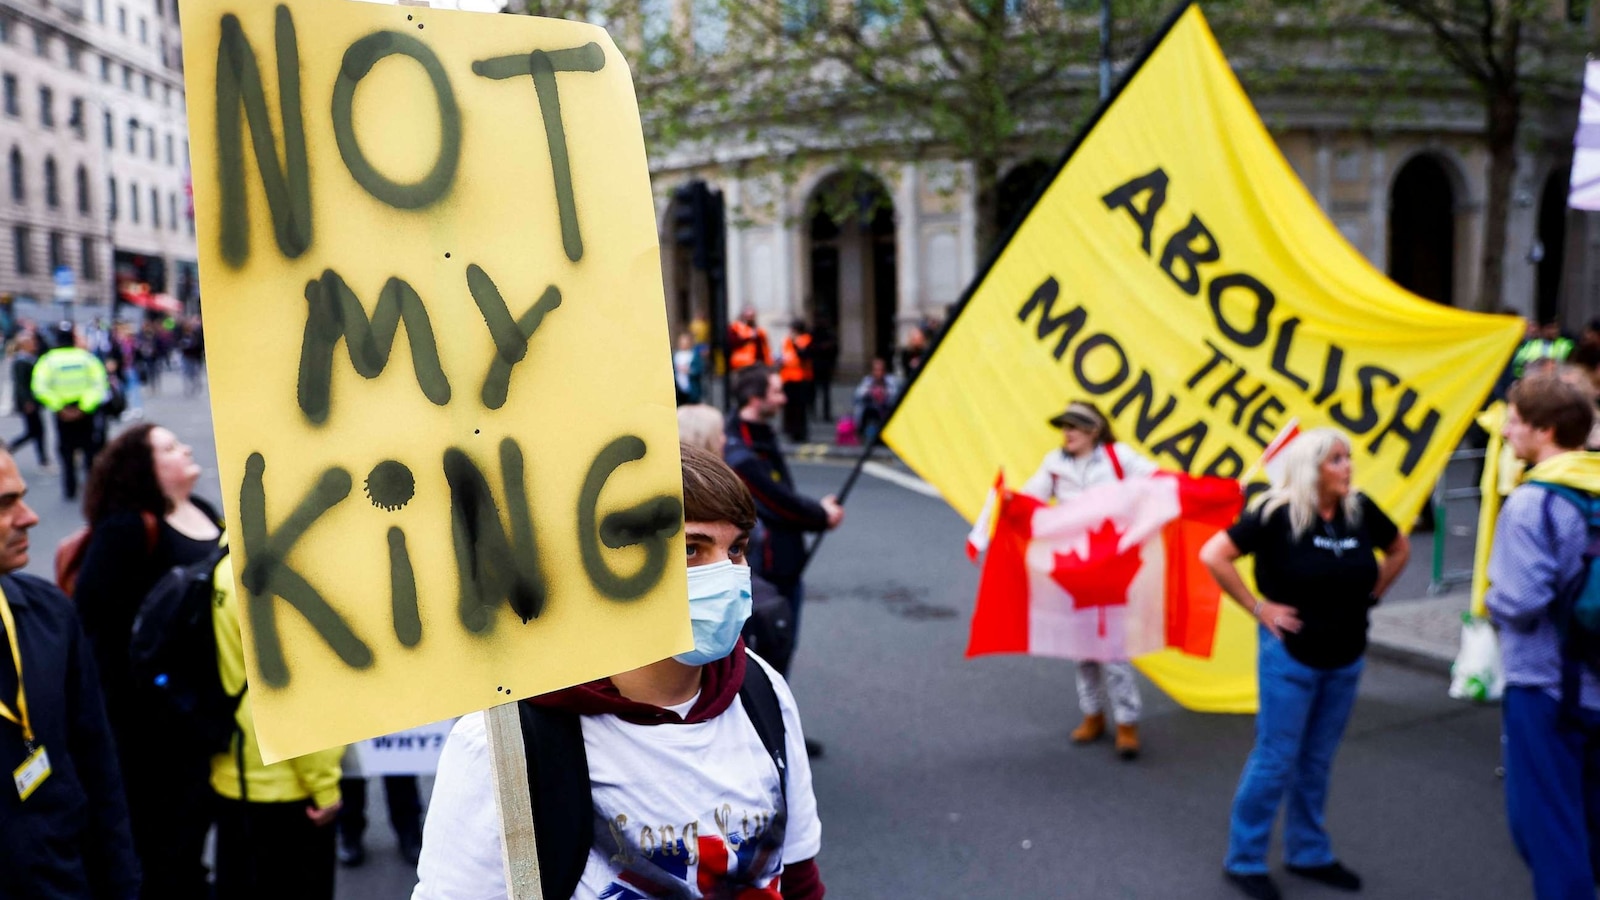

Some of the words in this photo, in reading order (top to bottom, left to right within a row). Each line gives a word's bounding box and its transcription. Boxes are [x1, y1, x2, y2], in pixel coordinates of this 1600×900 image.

[215, 3, 606, 270] NOT
[297, 263, 563, 426] MY
[1018, 275, 1270, 505] MONAR
[1102, 167, 1442, 478] ABOLISH
[1186, 339, 1286, 449] THE
[608, 813, 699, 867] Long
[713, 803, 775, 852] Liv
